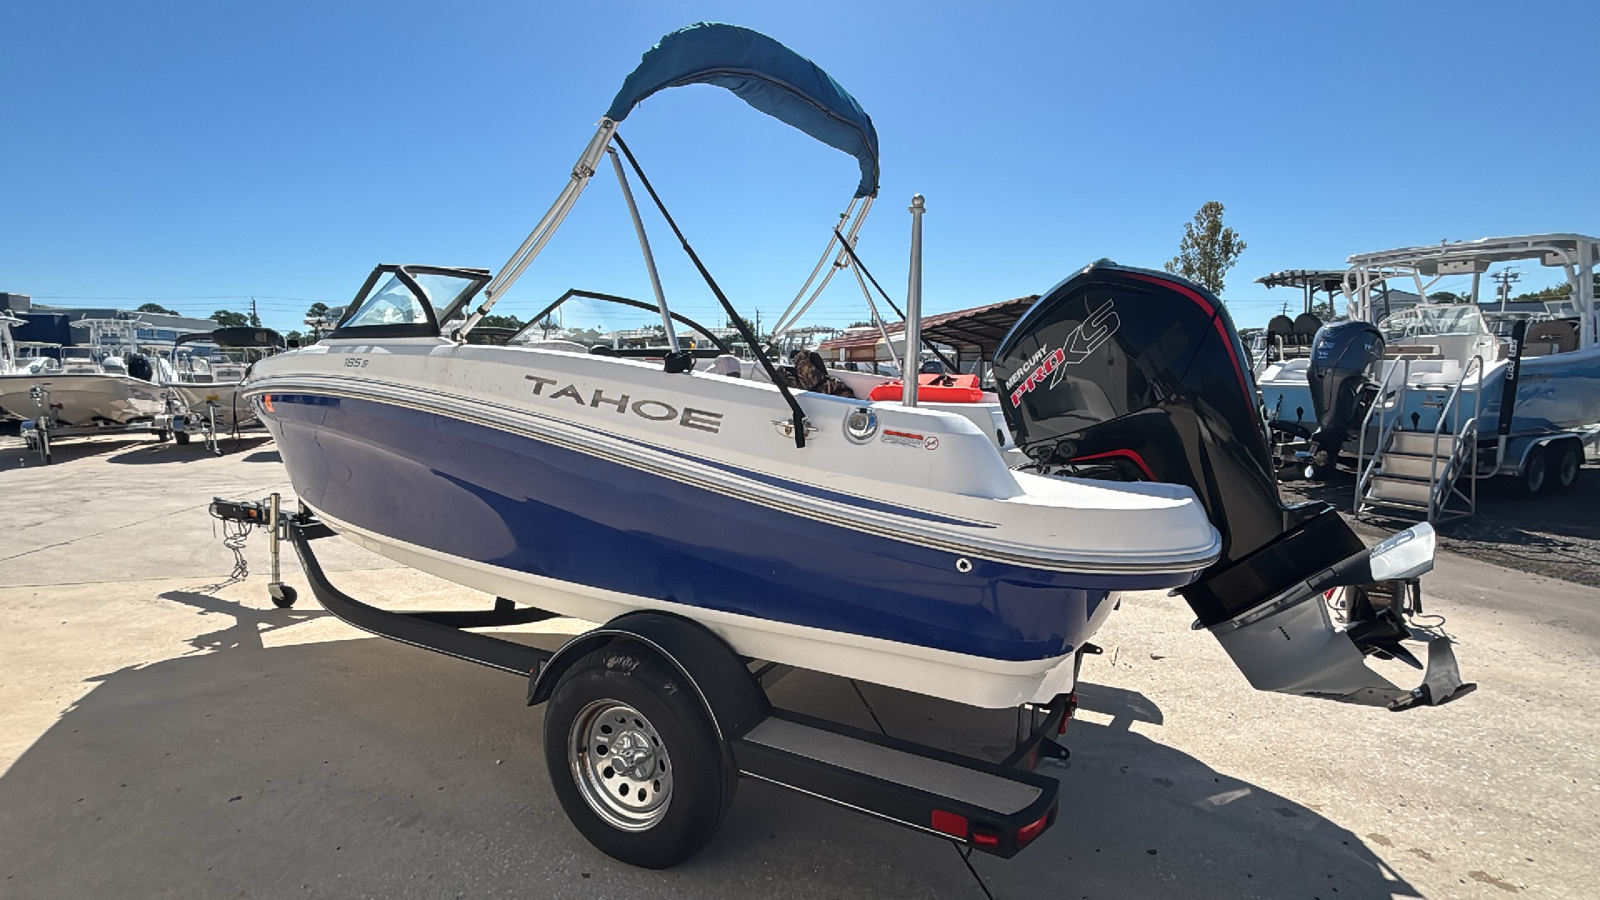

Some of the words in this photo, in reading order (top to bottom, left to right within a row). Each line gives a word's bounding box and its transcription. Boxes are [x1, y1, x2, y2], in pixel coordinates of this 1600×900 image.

[1005, 343, 1047, 390] MERCURY
[1506, 361, 1516, 380] PRO
[1508, 339, 1518, 358] SEA
[1010, 347, 1065, 408] PRO
[525, 374, 723, 434] TAHOE
